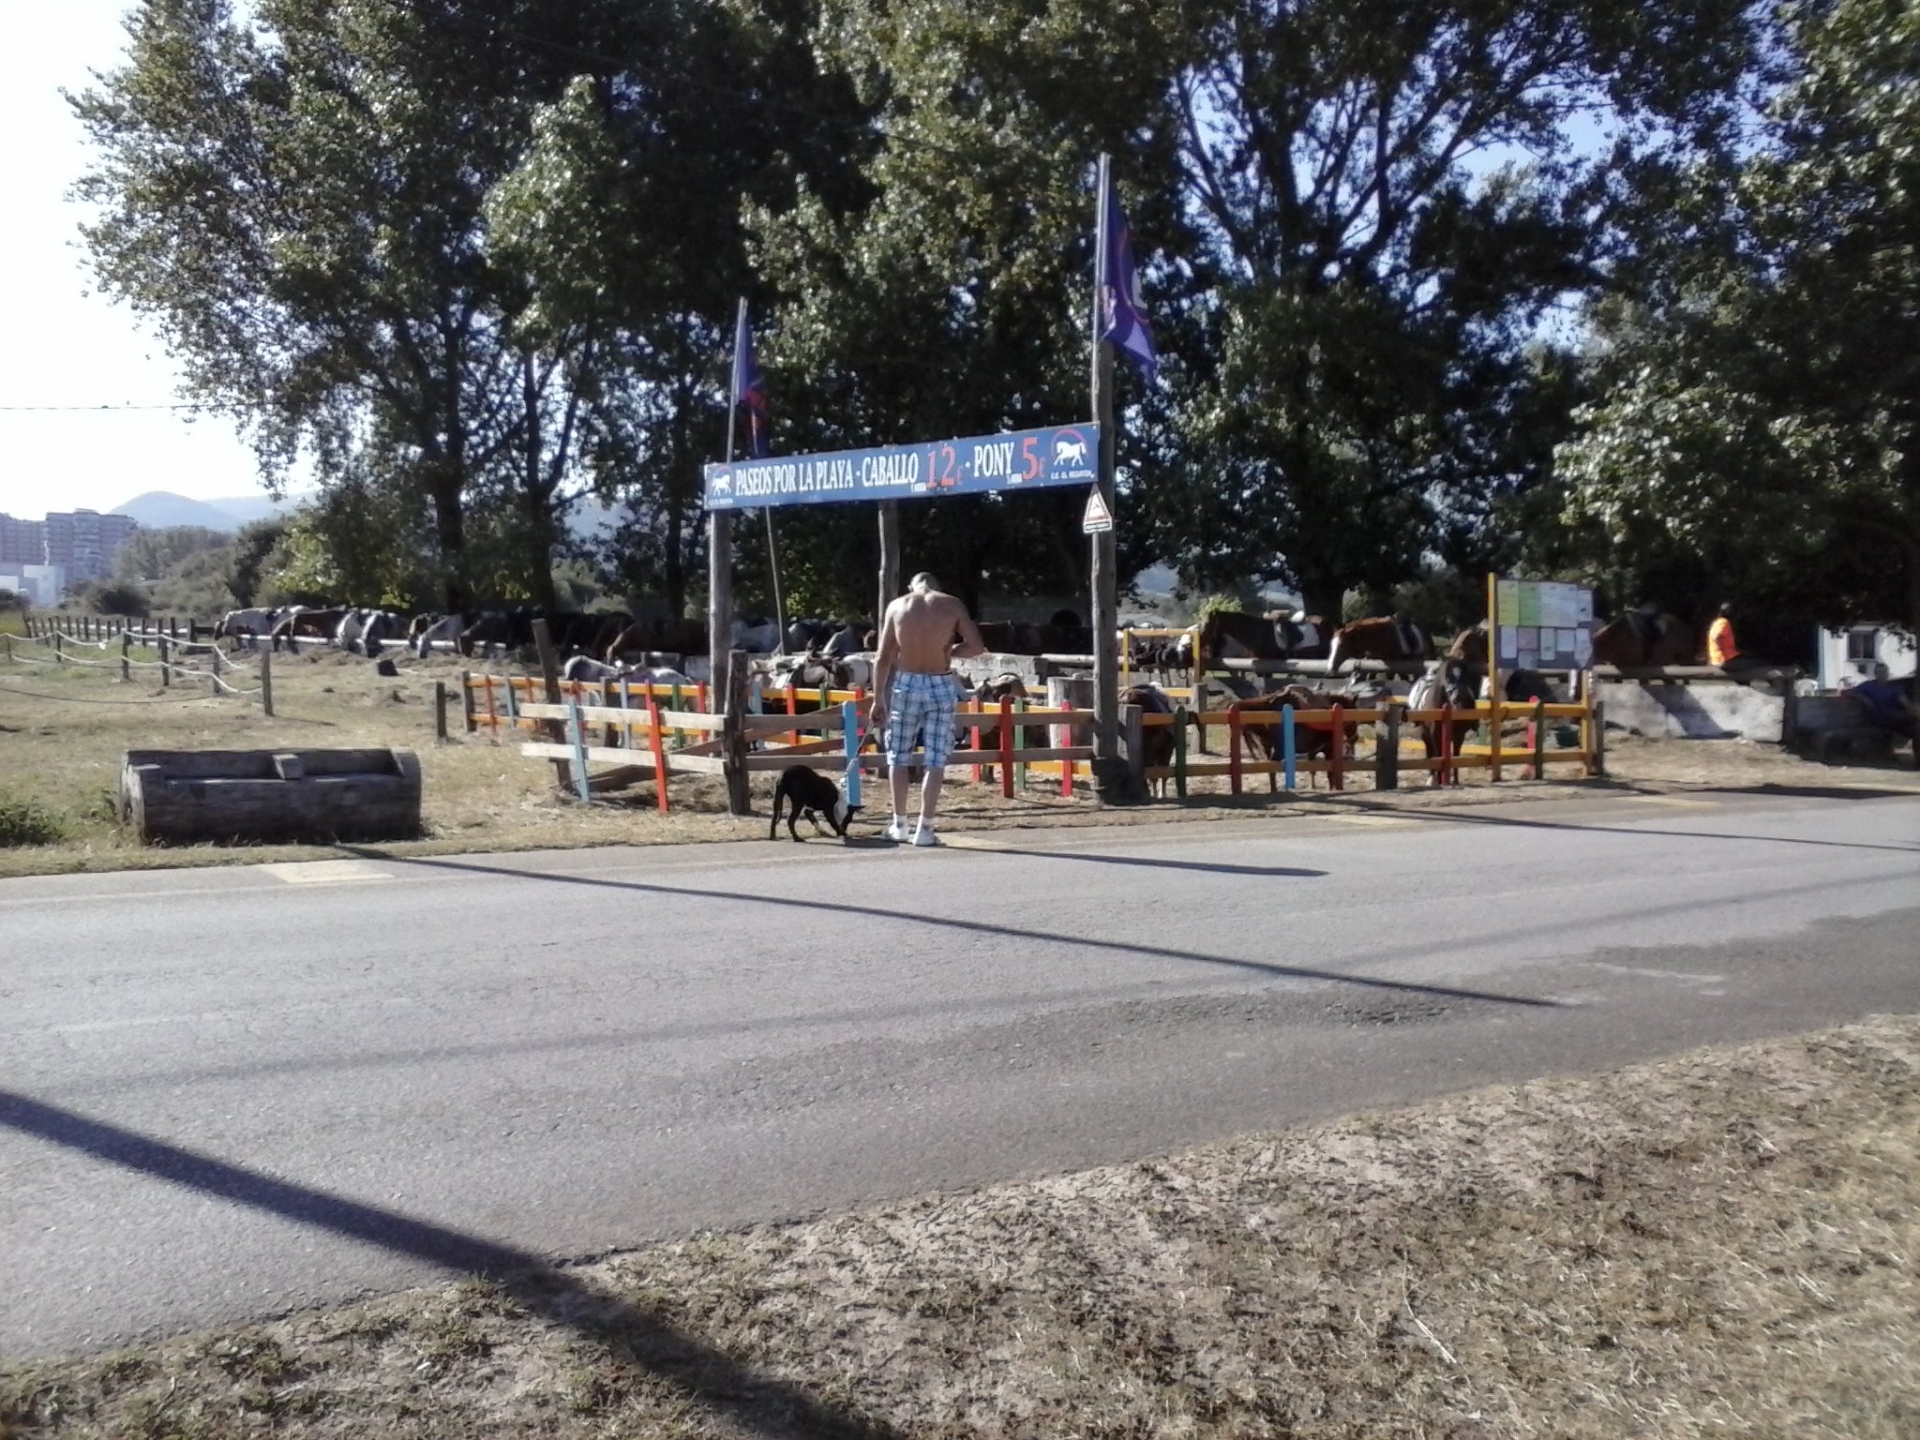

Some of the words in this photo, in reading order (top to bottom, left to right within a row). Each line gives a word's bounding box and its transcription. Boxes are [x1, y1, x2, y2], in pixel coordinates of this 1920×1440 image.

[735, 468, 771, 496] PASEOS
[772, 464, 796, 493] POR
[799, 462, 815, 491] LA
[816, 458, 854, 489] PLAYA
[862, 453, 918, 487] CABALLO
[973, 441, 1015, 477] PONY
